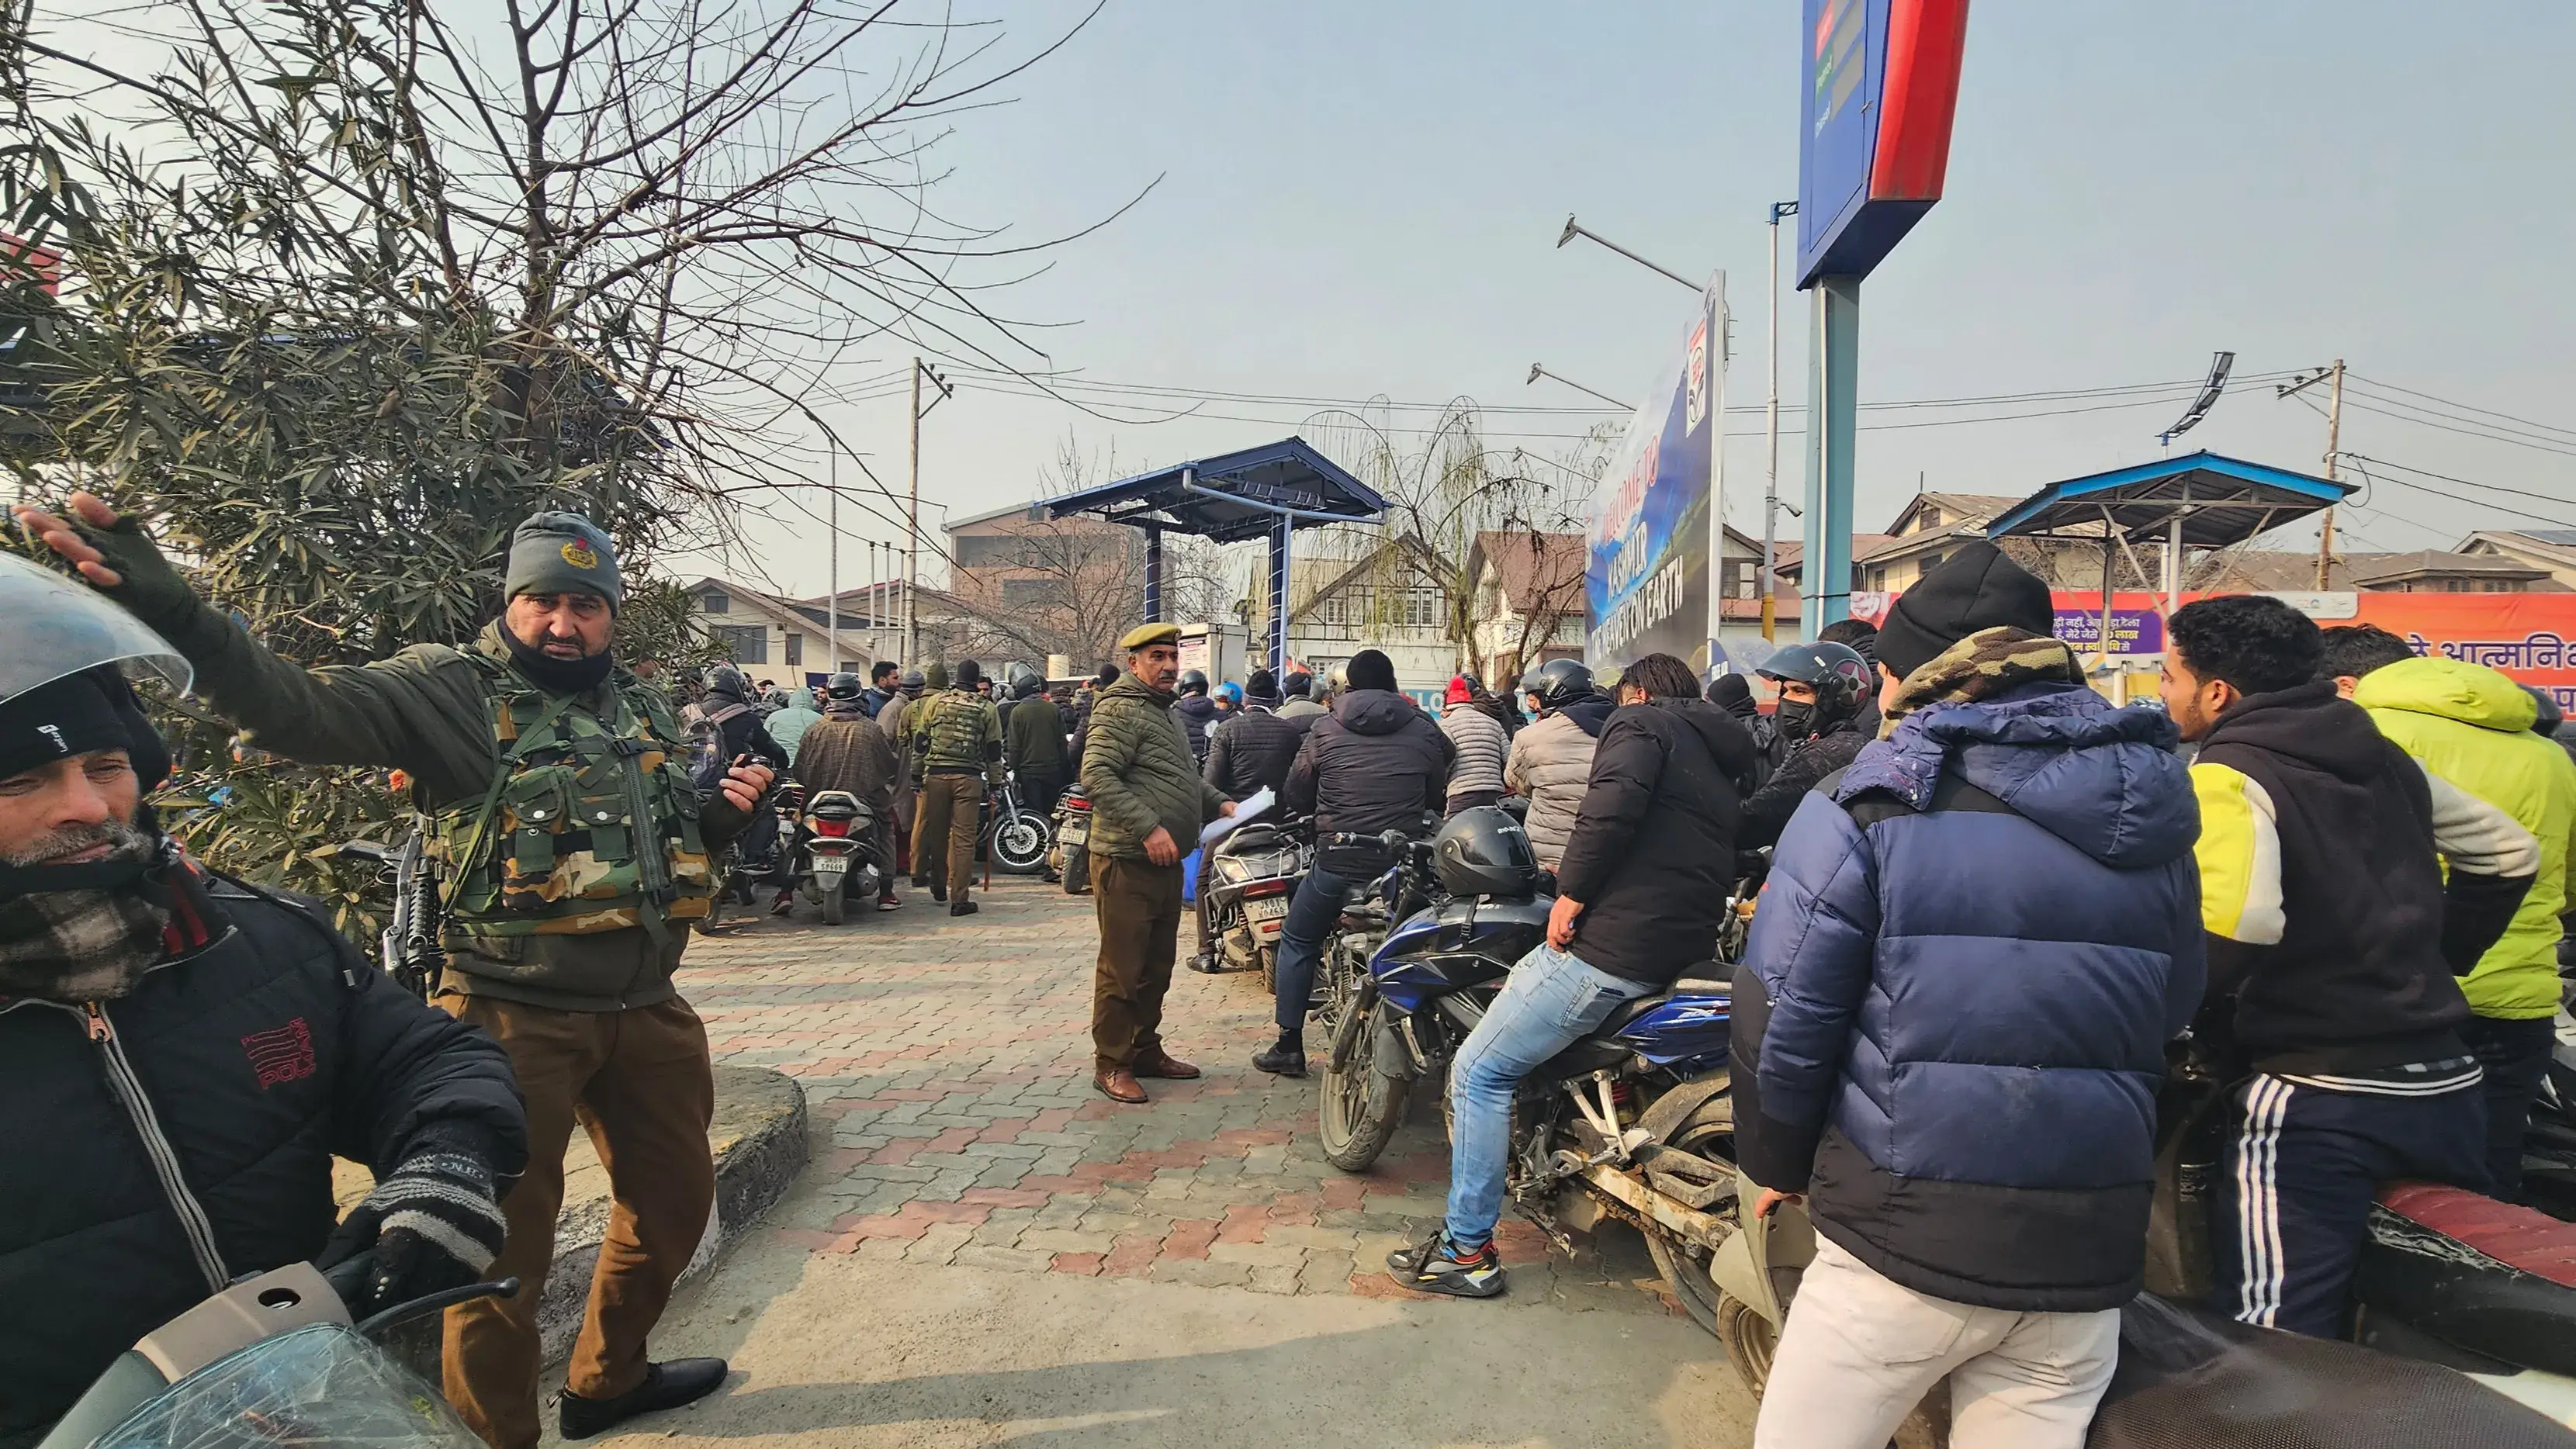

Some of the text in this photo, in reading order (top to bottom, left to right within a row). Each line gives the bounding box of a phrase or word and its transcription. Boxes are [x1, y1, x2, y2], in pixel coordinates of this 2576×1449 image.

[1601, 436, 1659, 547] WELCOME TO
[1601, 601, 1629, 658] HEAVEN
[1629, 589, 1644, 639] ON
[1646, 555, 1683, 630] EARTH
[1607, 521, 1647, 603] KASHMIR
